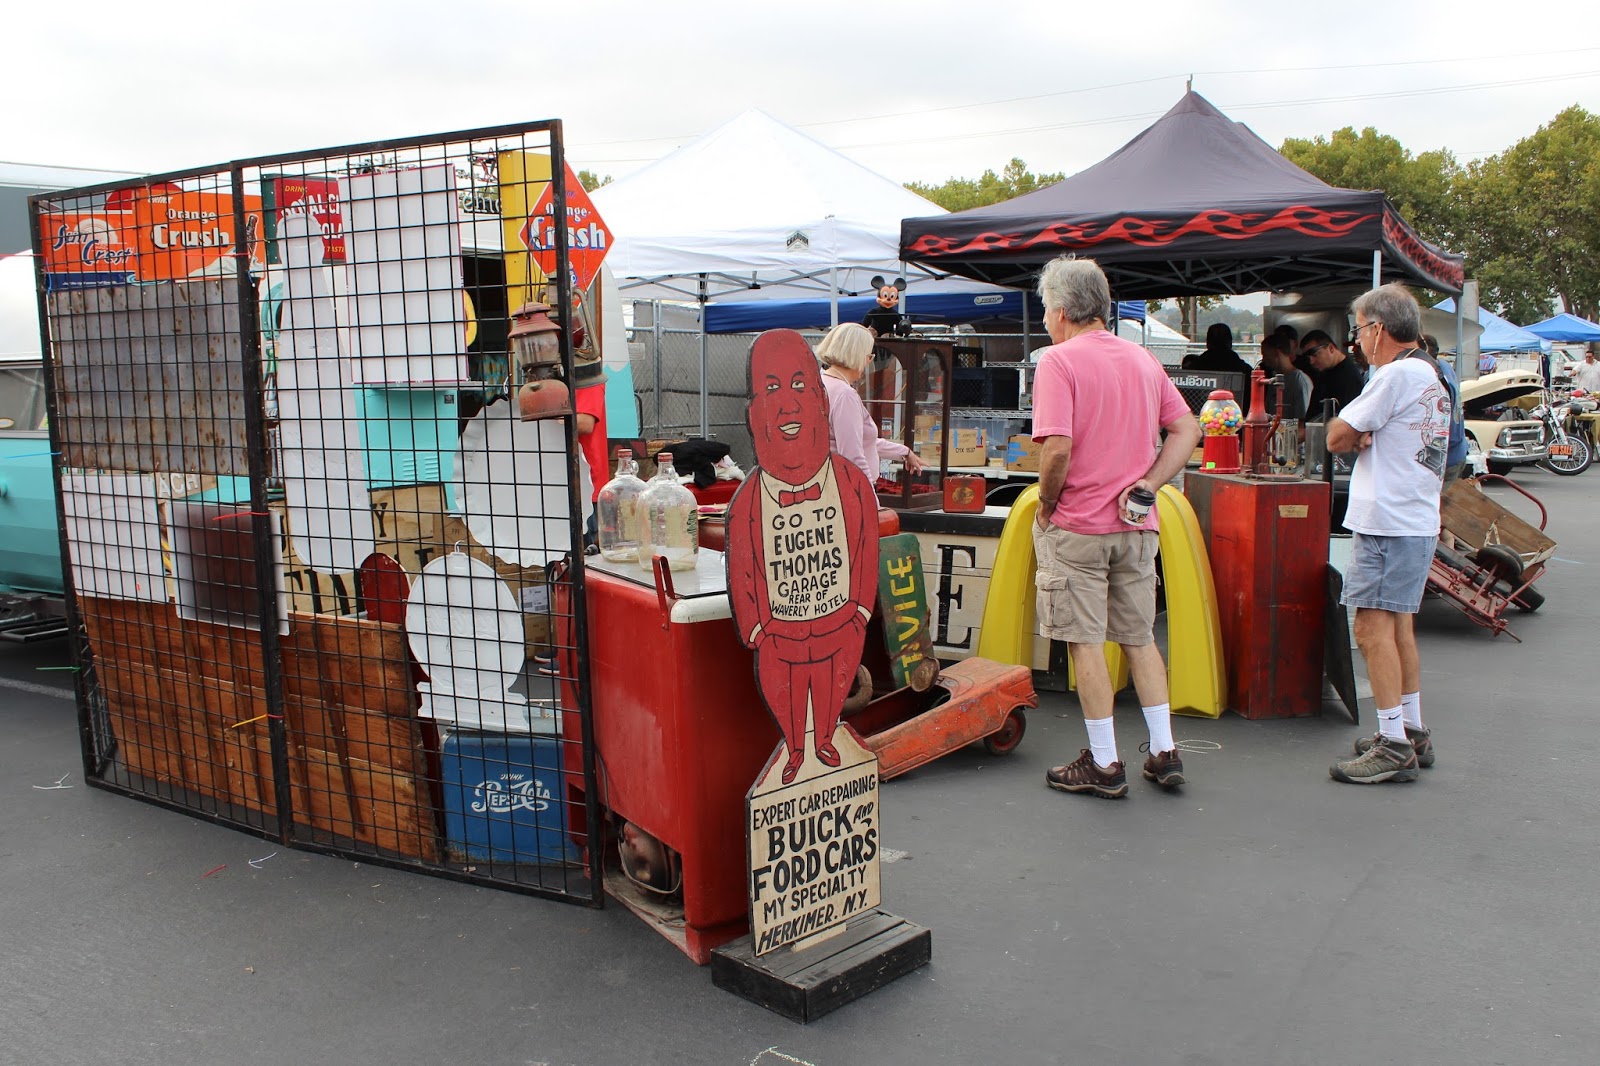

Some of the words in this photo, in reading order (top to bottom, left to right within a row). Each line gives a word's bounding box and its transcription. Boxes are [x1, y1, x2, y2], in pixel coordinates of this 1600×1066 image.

[167, 208, 217, 224] Orange
[151, 225, 229, 248] Crush
[321, 223, 343, 239] OLA
[1549, 445, 1559, 454] FOR
[1560, 445, 1573, 454] SALE
[772, 513, 803, 530] GO
[812, 506, 837, 522] TO
[774, 525, 834, 555] EUGENE
[769, 547, 843, 581] THOMAS
[778, 570, 838, 598] GARAGE
[789, 593, 811, 604] REAR
[816, 589, 828, 601] OF
[771, 600, 809, 617] WAVERLY
[814, 593, 847, 615] HOTEL
[753, 798, 797, 831] EXPERT
[798, 793, 821, 816] CAR
[822, 773, 876, 806] REPAIRING
[767, 803, 854, 862] BUICK
[853, 801, 875, 824] AND
[752, 848, 821, 902] FORD
[824, 828, 877, 874] CARS
[763, 894, 787, 924] MY
[790, 864, 867, 912] SPECIALTY
[842, 888, 868, 917] N.Y.
